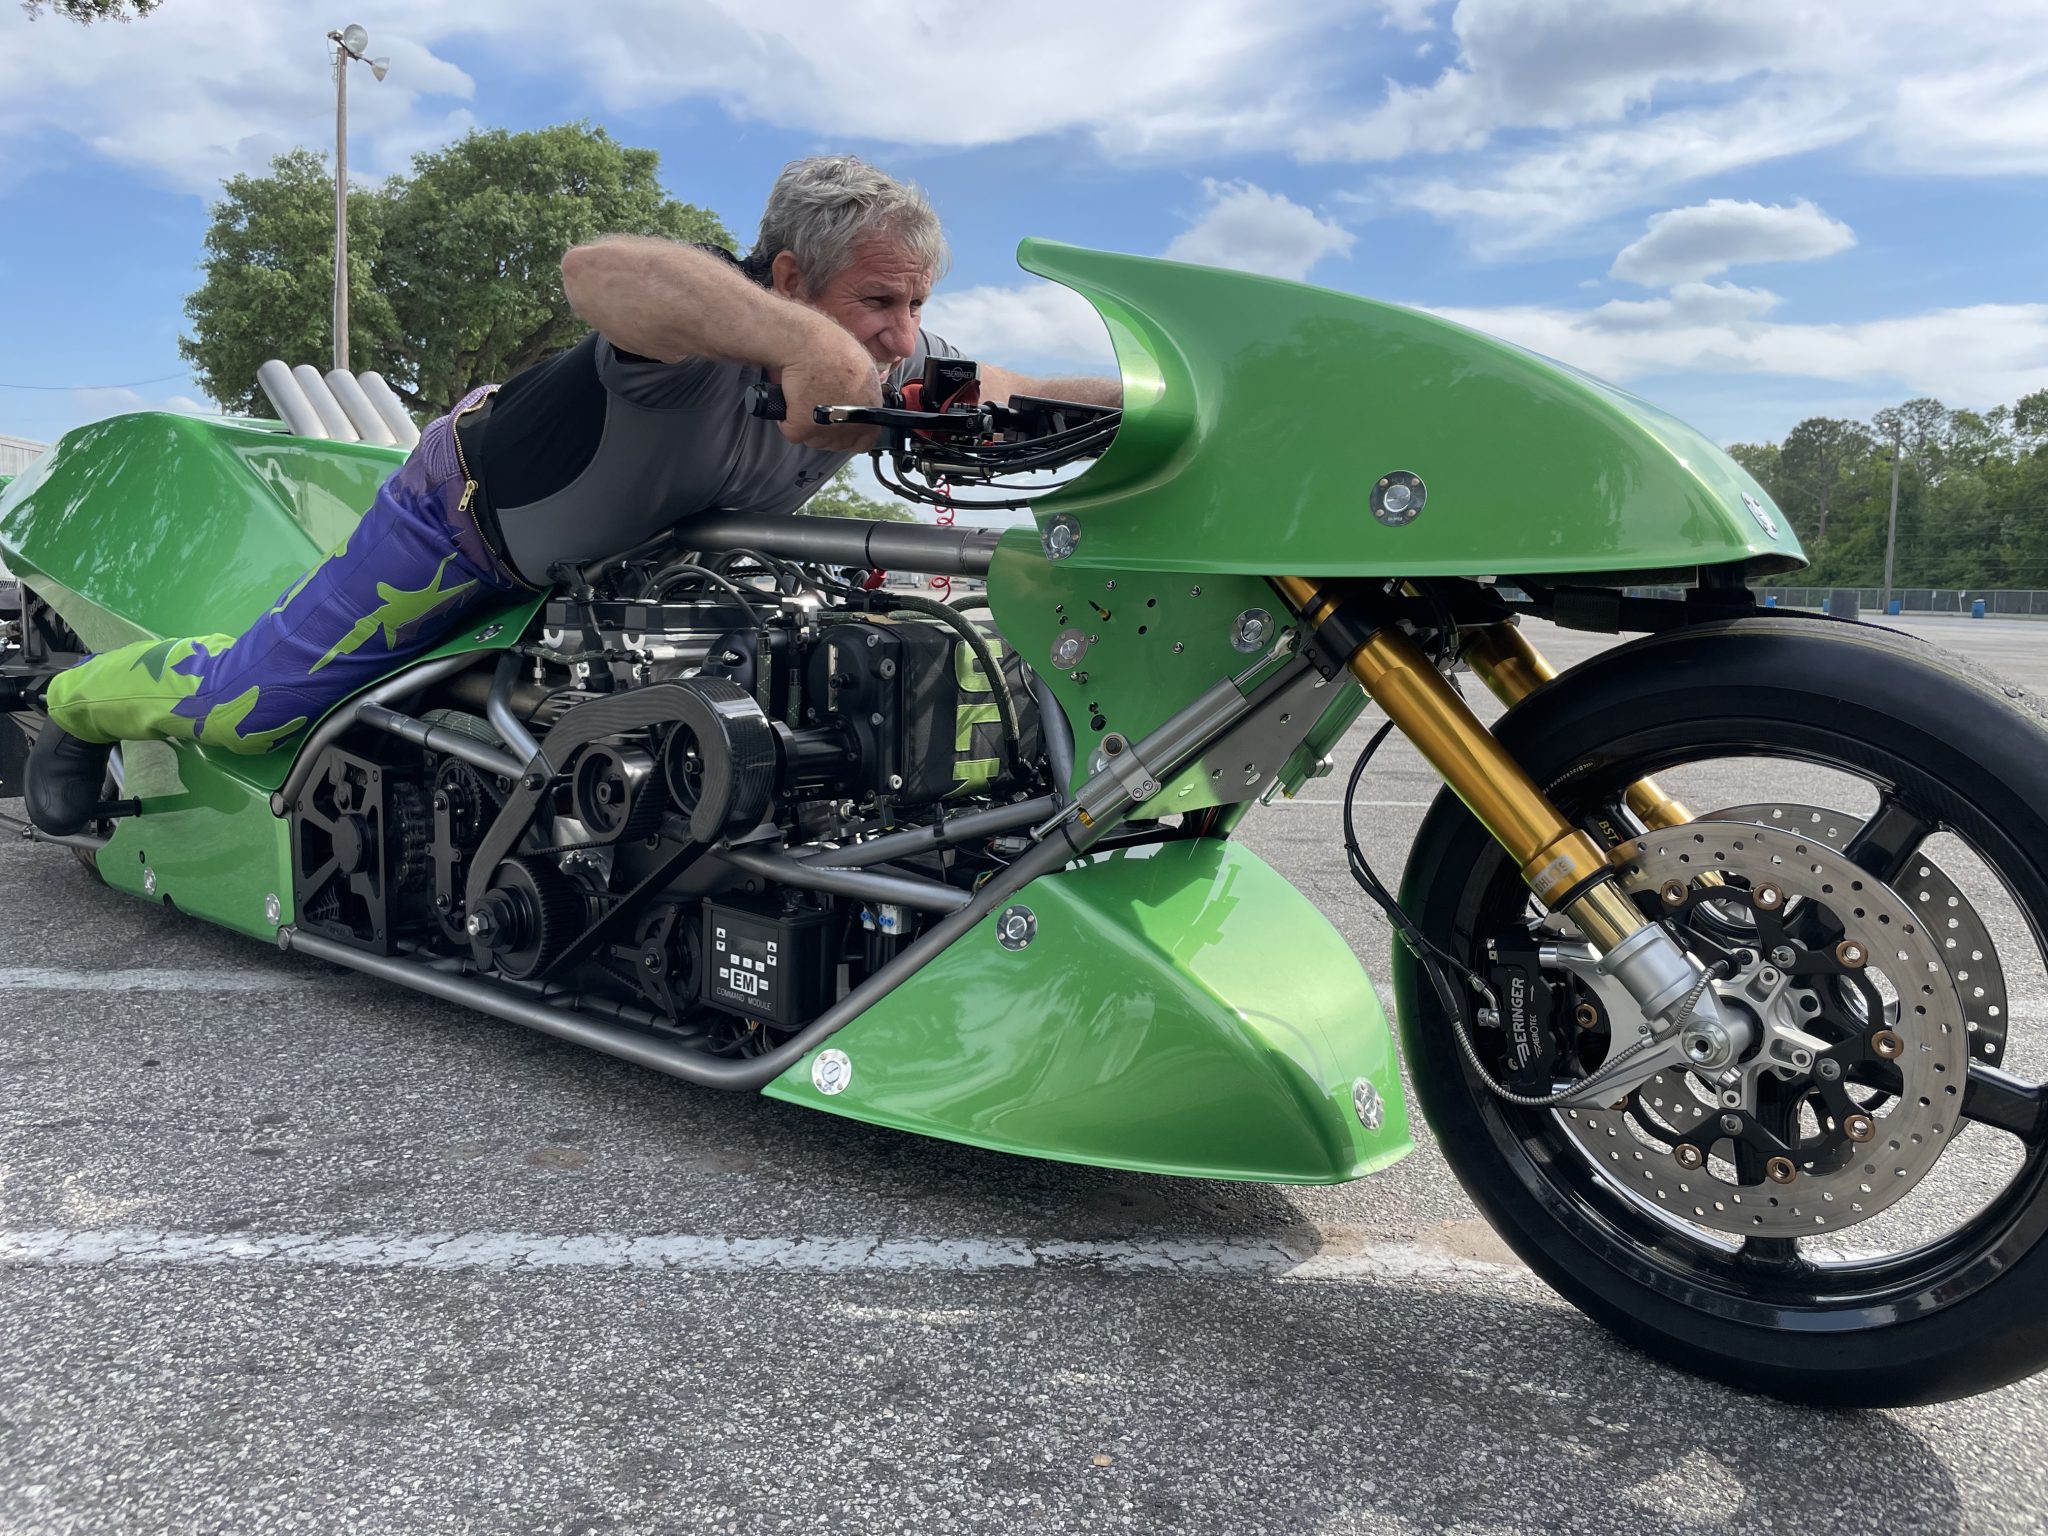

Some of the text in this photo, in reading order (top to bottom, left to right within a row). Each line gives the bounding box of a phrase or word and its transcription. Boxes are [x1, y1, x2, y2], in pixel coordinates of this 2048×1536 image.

[1598, 820, 1619, 842] BST
[733, 971, 754, 993] EM
[716, 986, 772, 1011] COMMAND MODULE
[1511, 977, 1530, 1069] BERINGER
[1530, 1013, 1543, 1059] AEROTEC
